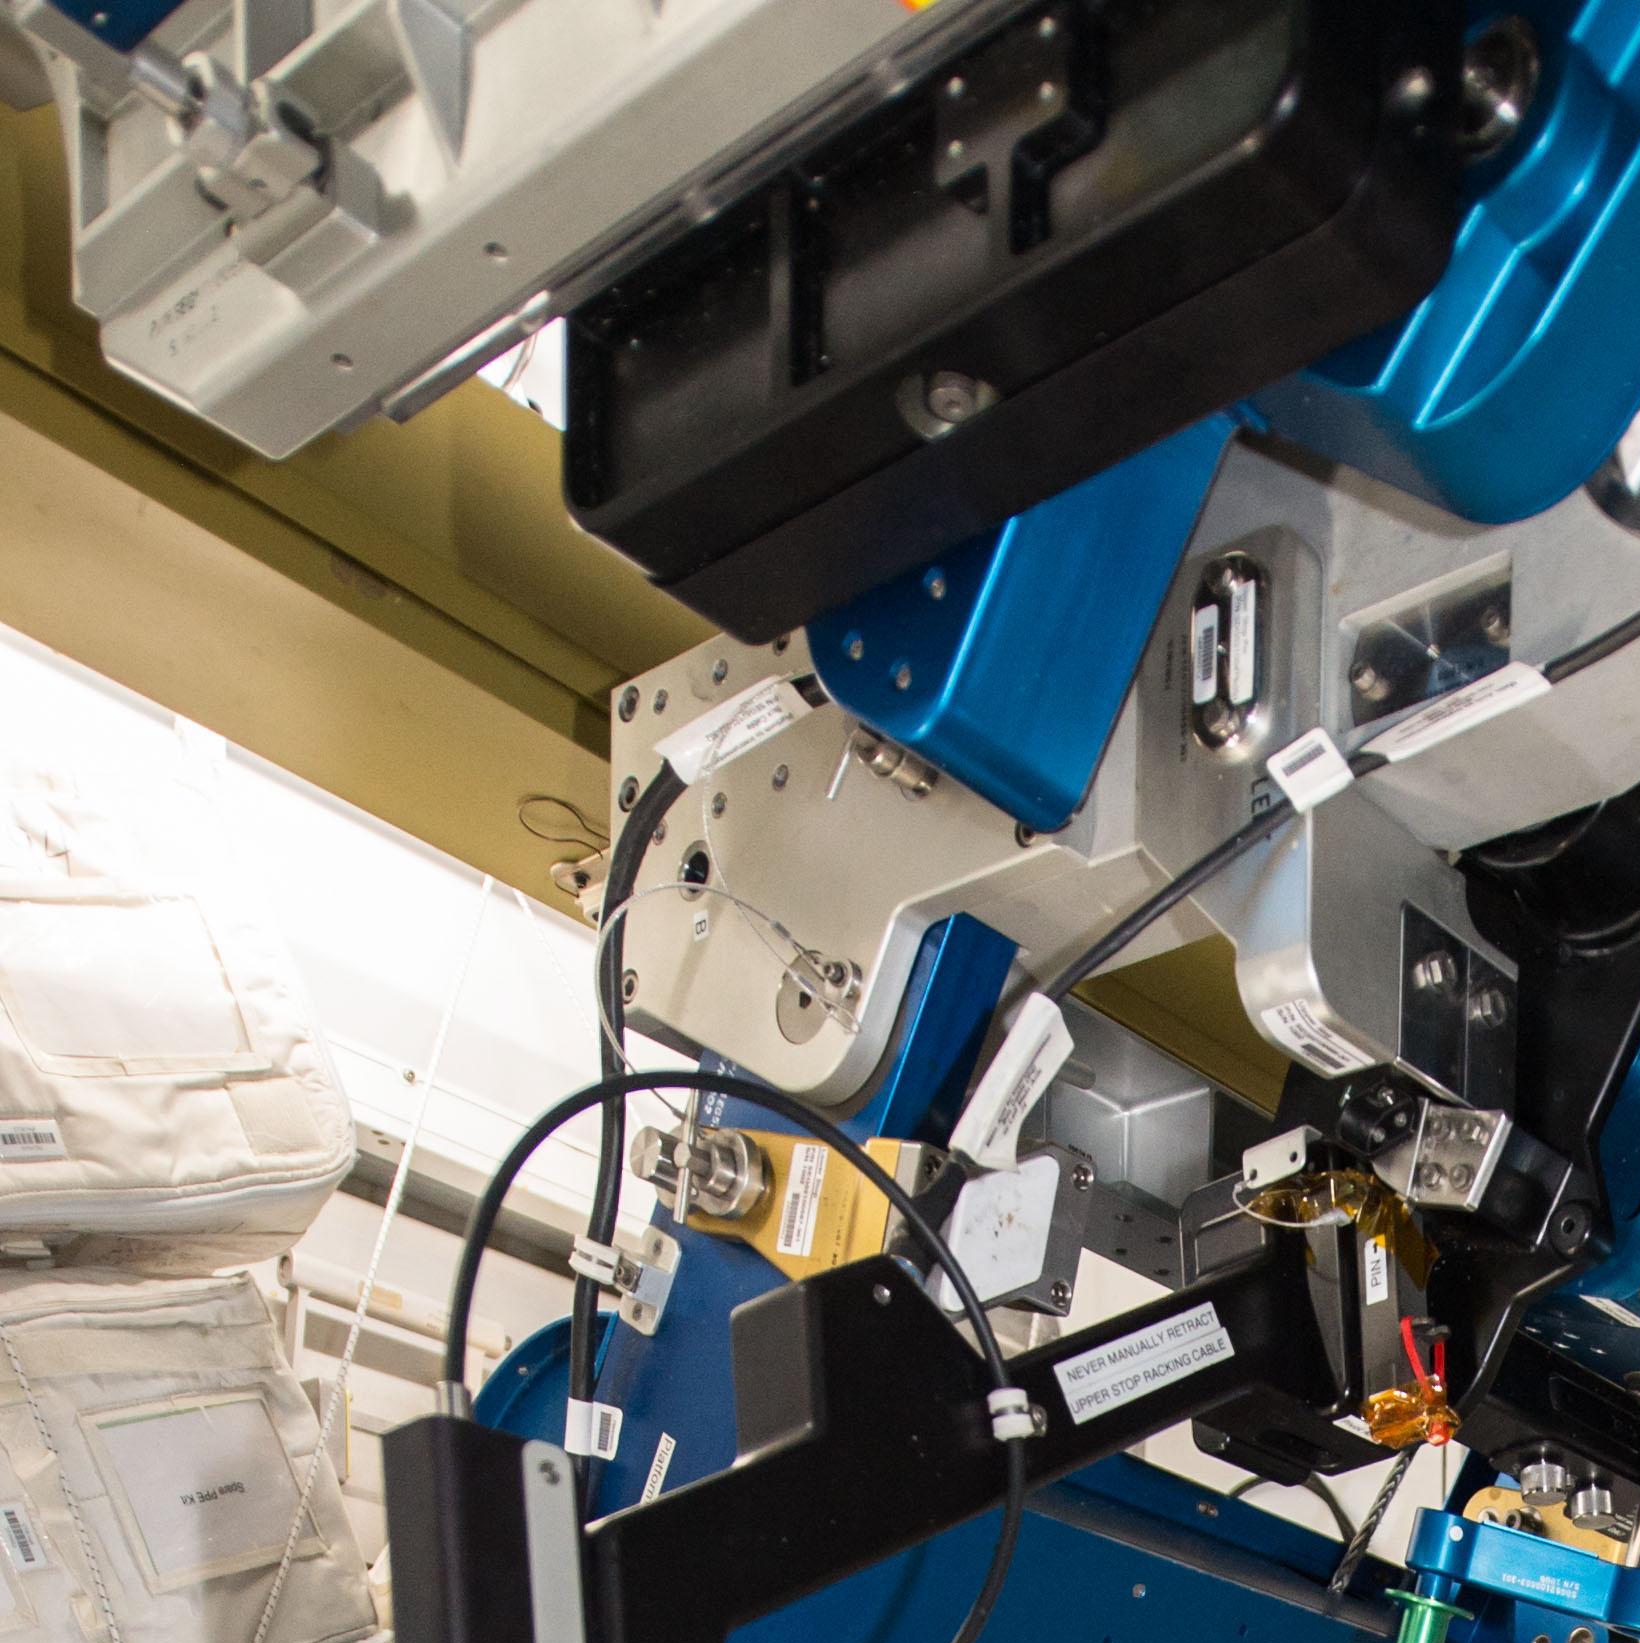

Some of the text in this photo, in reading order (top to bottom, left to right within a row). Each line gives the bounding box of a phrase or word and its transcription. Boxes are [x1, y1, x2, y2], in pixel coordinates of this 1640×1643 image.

[694, 920, 708, 935] B
[1370, 1259, 1382, 1288] PIN
[1067, 1311, 1216, 1382] NEVER MANUALLY RETRACT
[1071, 1338, 1227, 1415] UPPER STOP RACKING CABLE
[181, 1481, 245, 1506] Spare PPE Kit
[645, 1437, 673, 1504] Platform
